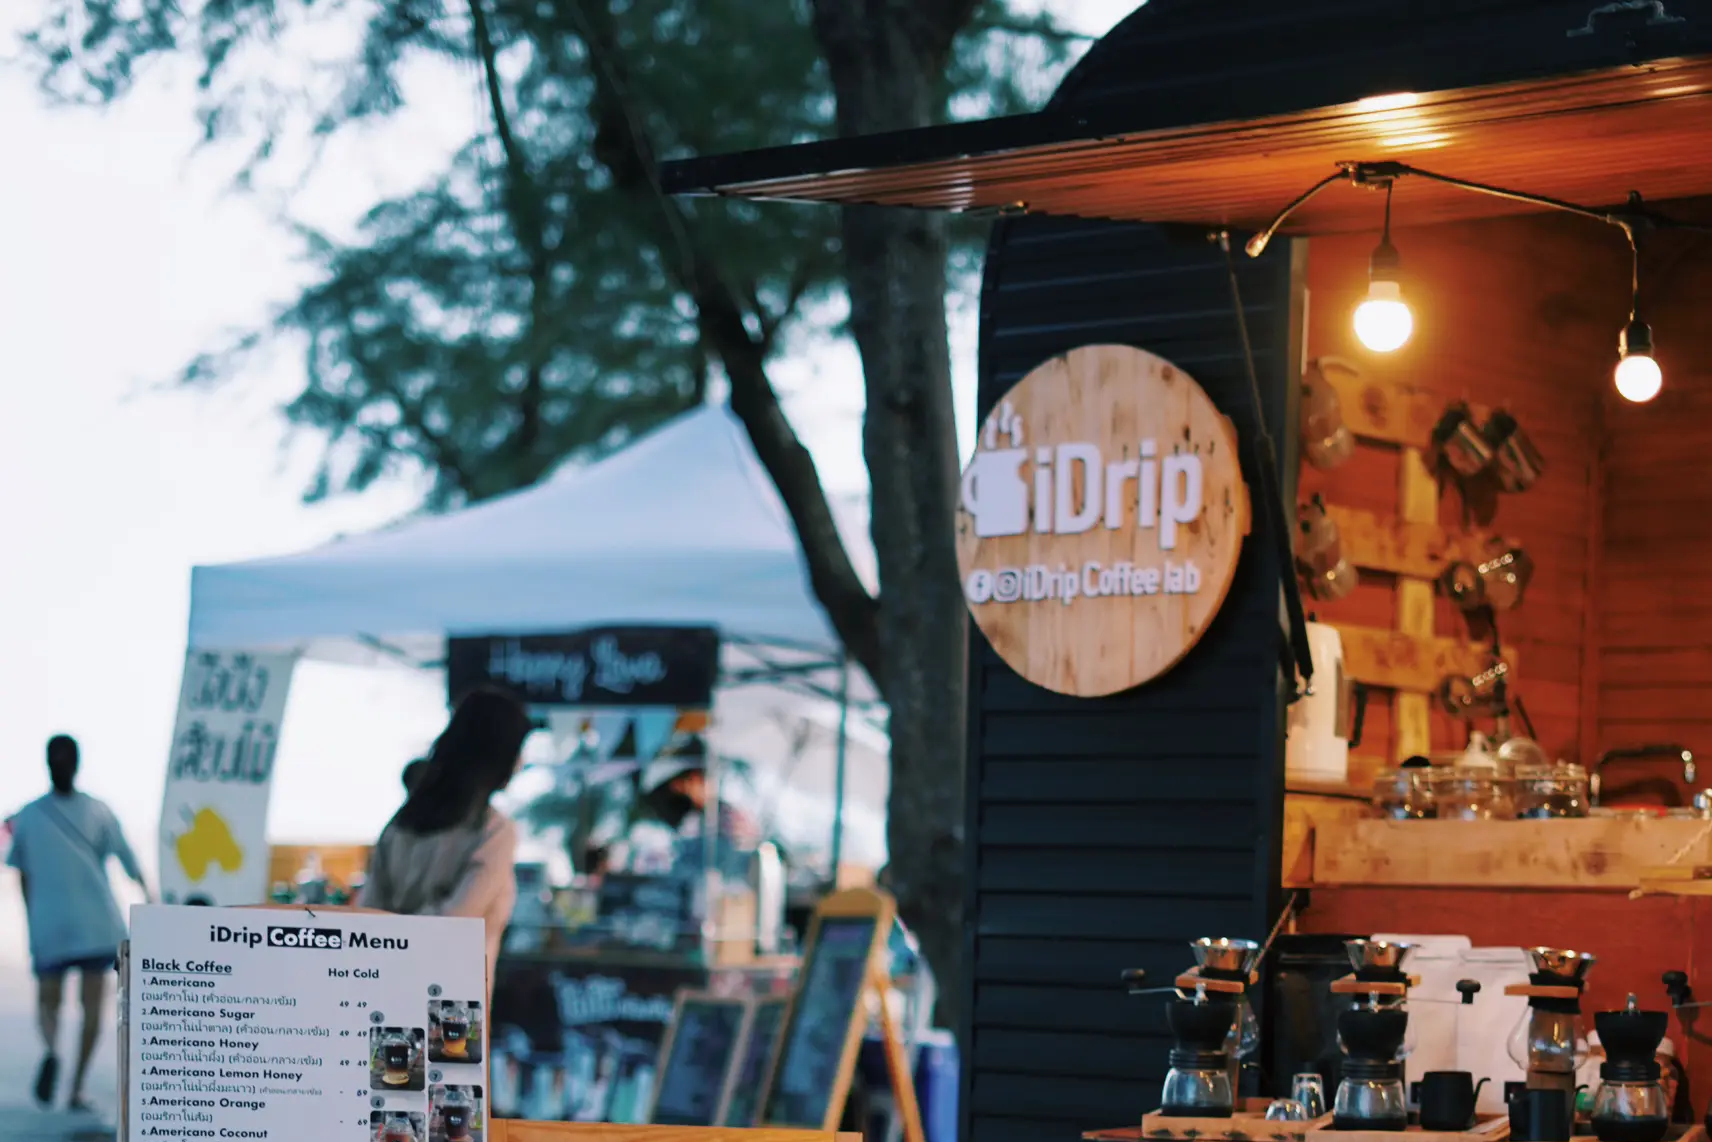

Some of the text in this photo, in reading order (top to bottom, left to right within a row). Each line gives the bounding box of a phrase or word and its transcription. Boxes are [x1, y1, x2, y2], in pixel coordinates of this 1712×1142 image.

[1034, 439, 1202, 549] iDrip
[1023, 566, 1079, 606] iDrip
[1082, 563, 1158, 597] Coffee
[210, 925, 408, 950] iDrip Coffee Menu
[142, 959, 232, 974] Black Coffee
[329, 968, 379, 979] Hot Cold
[220, 1009, 255, 1024] Sugar
[220, 1039, 259, 1051] Honey
[220, 1069, 259, 1079] Lemon
[263, 1070, 302, 1082] Honey
[220, 1098, 266, 1111] Orange
[220, 1128, 268, 1139] Coconut
